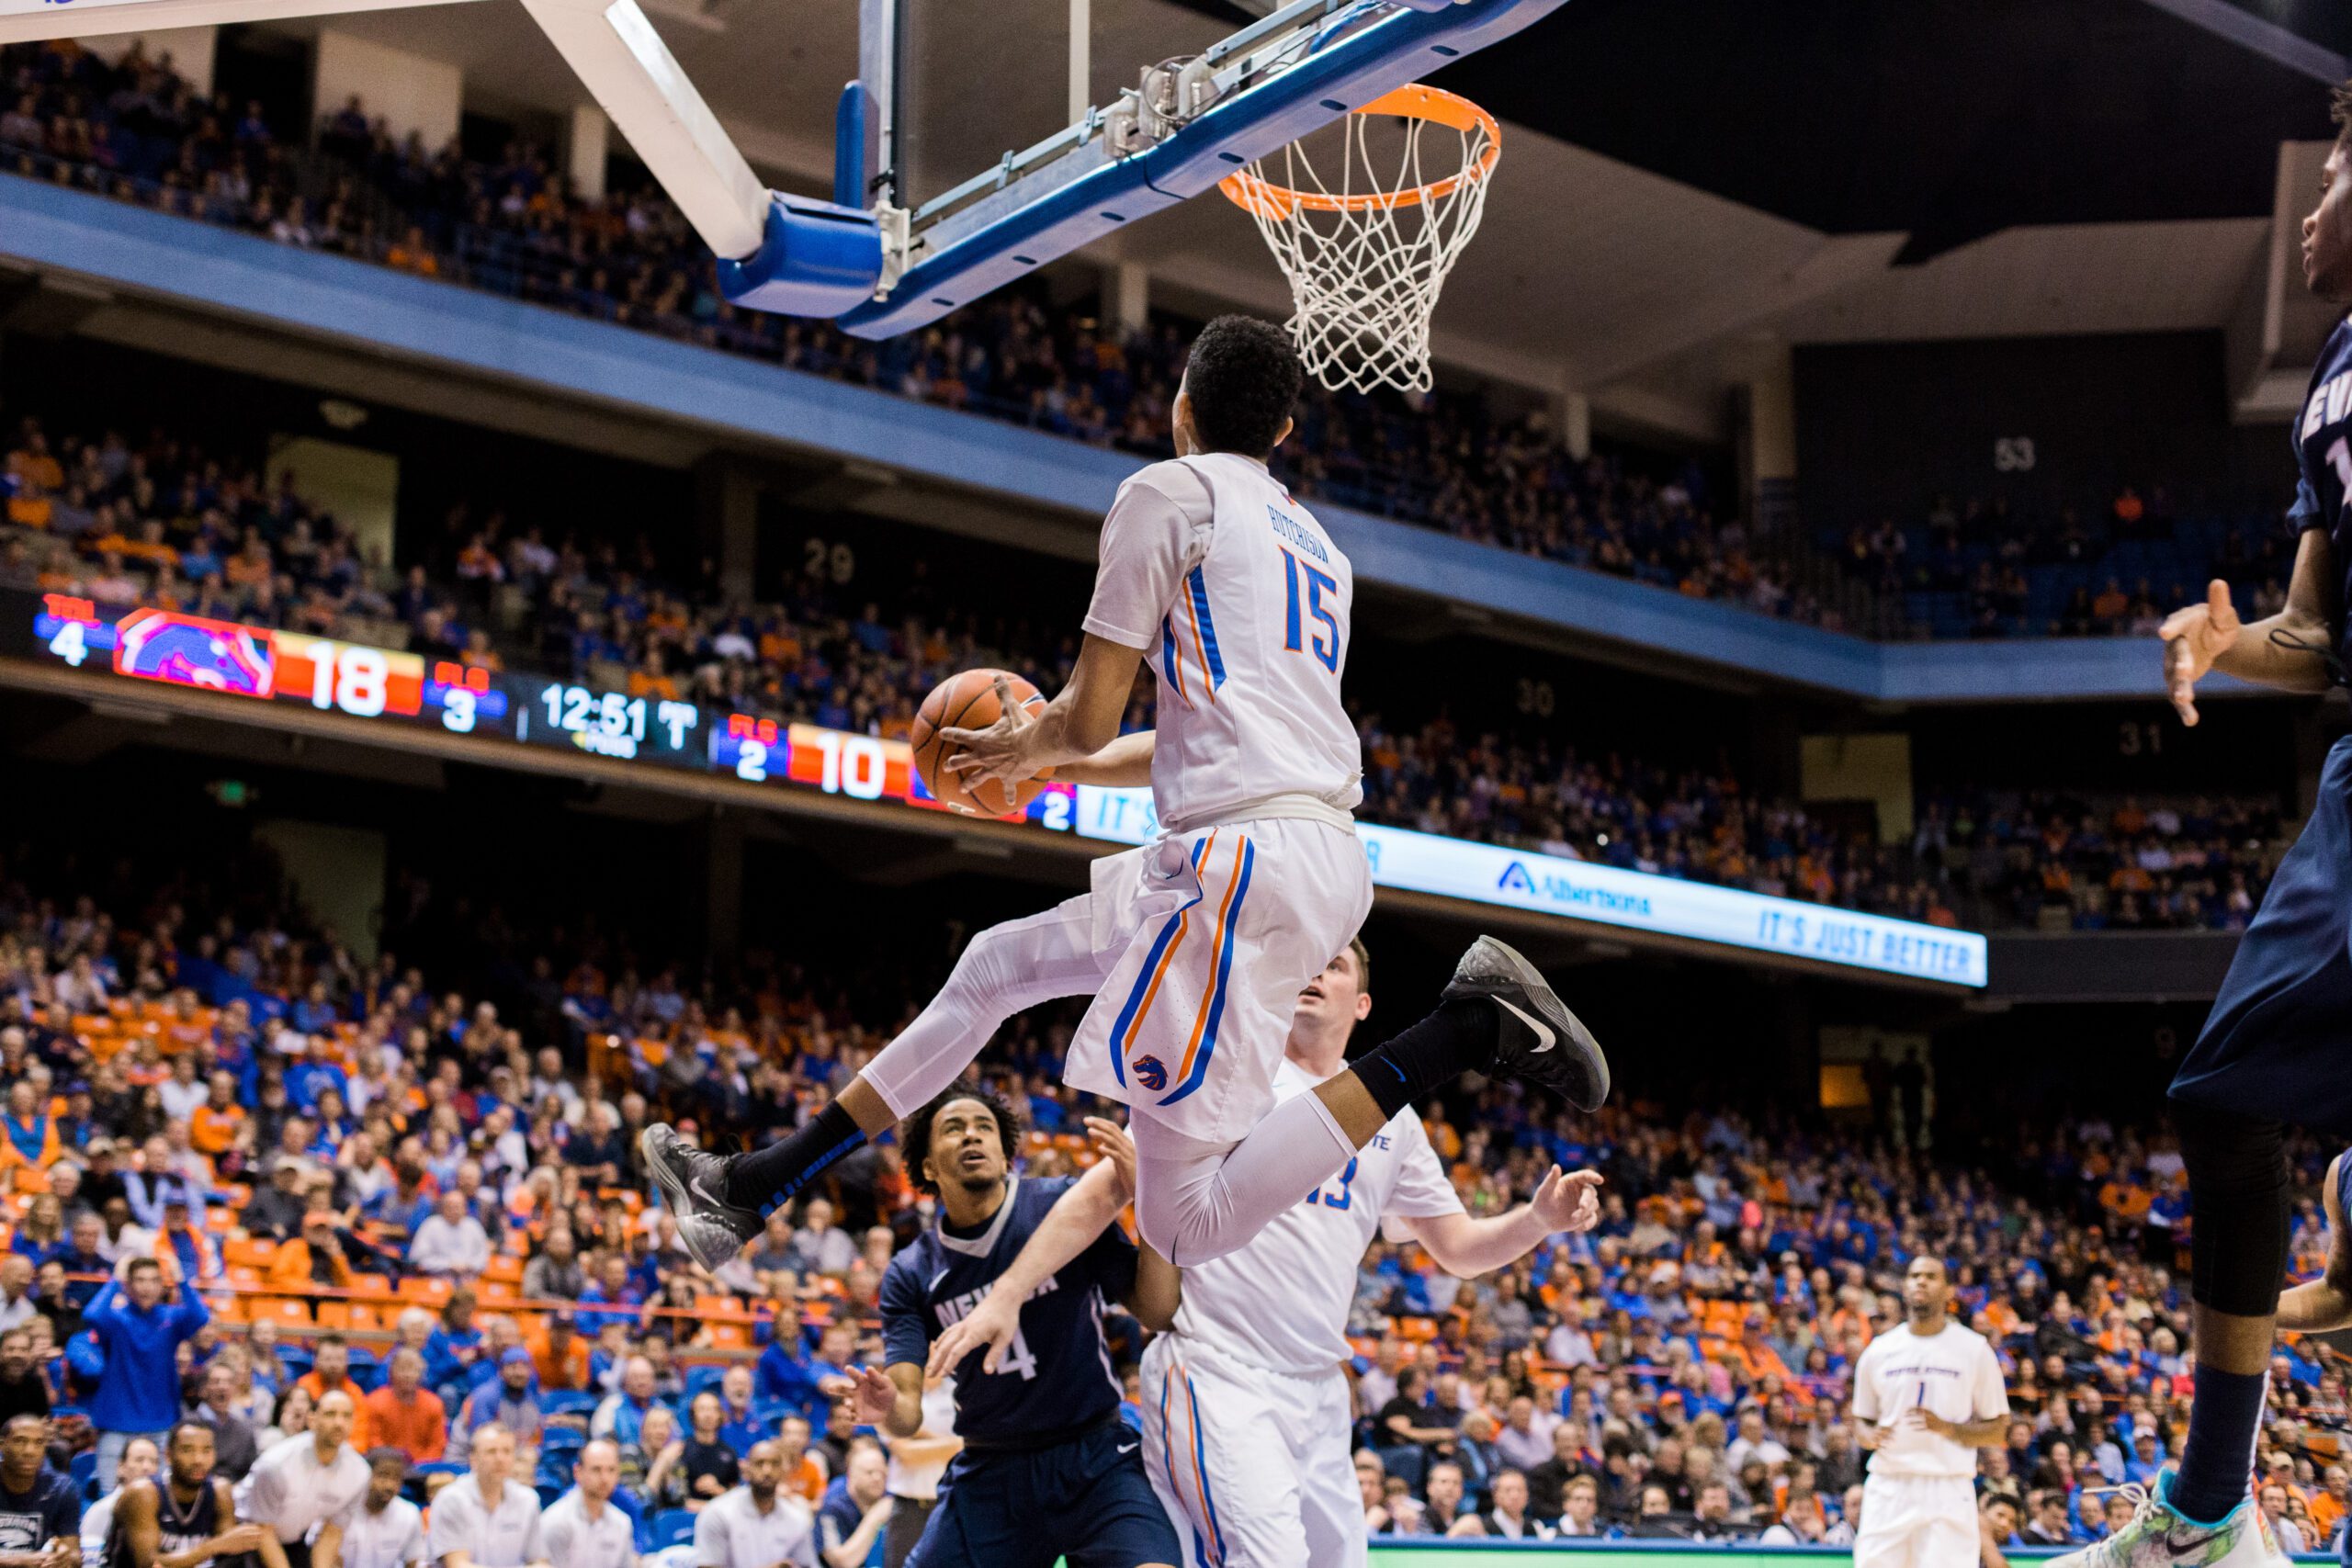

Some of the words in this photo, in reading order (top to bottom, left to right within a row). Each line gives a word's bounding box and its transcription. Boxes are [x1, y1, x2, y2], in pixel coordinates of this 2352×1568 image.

[804, 537, 854, 585] 29
[1267, 504, 1329, 563] HUTCHISON
[1277, 544, 1340, 675] 15
[50, 621, 88, 666] 4
[306, 641, 388, 716] 18
[442, 688, 477, 732] 3
[541, 683, 646, 741] 12:51
[737, 740, 767, 782] 2
[816, 734, 886, 800] 10
[1042, 791, 1070, 831] 2
[1758, 909, 1806, 947] IT'S
[1815, 921, 1873, 958] JUST
[1883, 931, 1972, 974] BETTER
[995, 1325, 1038, 1382] 4
